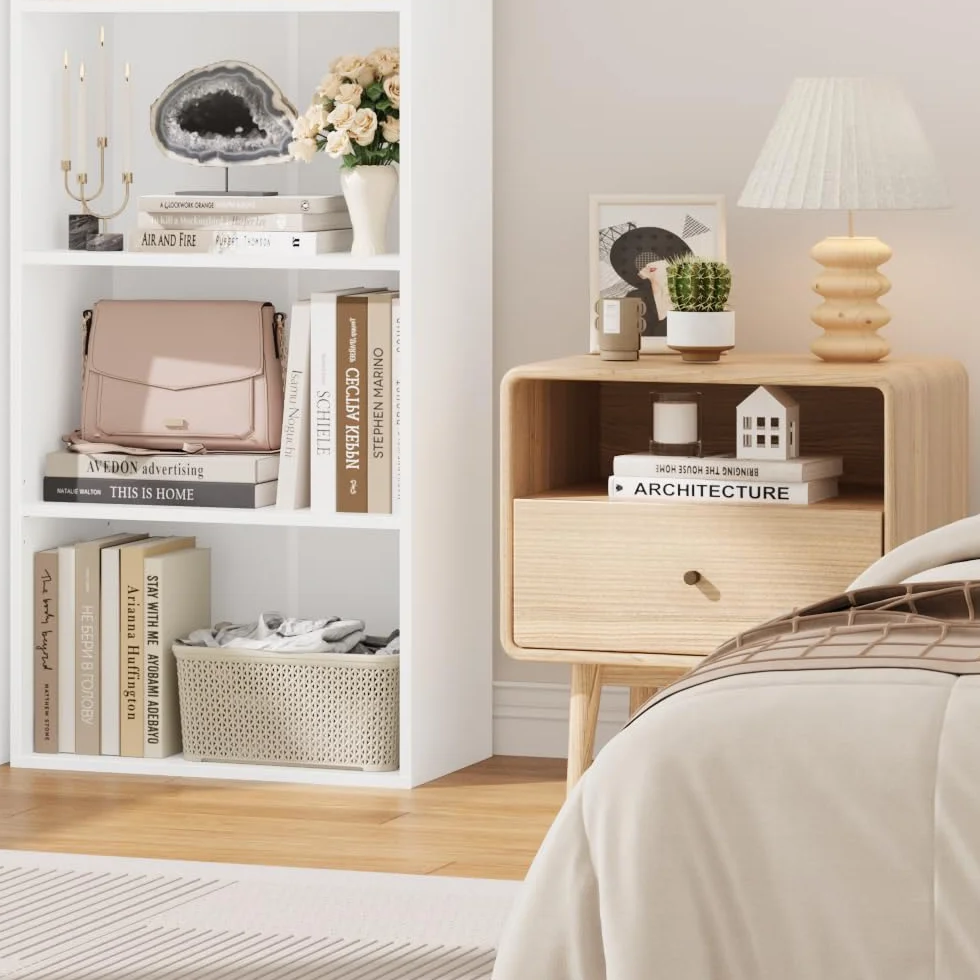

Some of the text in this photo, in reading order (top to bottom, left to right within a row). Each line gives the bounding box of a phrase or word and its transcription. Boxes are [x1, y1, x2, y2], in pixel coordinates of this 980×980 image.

[164, 202, 193, 210] CLOCKWORK
[141, 232, 196, 247] AIR AND FIRE
[373, 347, 384, 459] STEPHEN MARINO
[284, 370, 304, 458] Isamu Noguchi
[316, 390, 331, 456] SCHIELE
[86, 460, 204, 479] AVEDON advertising
[656, 464, 759, 477] BRINGING THE HOUSE HOME
[79, 488, 102, 496] WALTON
[110, 486, 194, 501] THIS IS HOME
[634, 483, 790, 500] ARCHITECTURE
[36, 568, 55, 670] The body beyond
[80, 605, 94, 622] НЕ
[80, 624, 94, 658] БЕРИ
[123, 585, 140, 720] Arianna Huffington
[147, 575, 159, 744] STAY WITH ME AYOBAMI ADEBAYO
[80, 661, 94, 670] В
[80, 673, 94, 725] ГОЛОВУ
